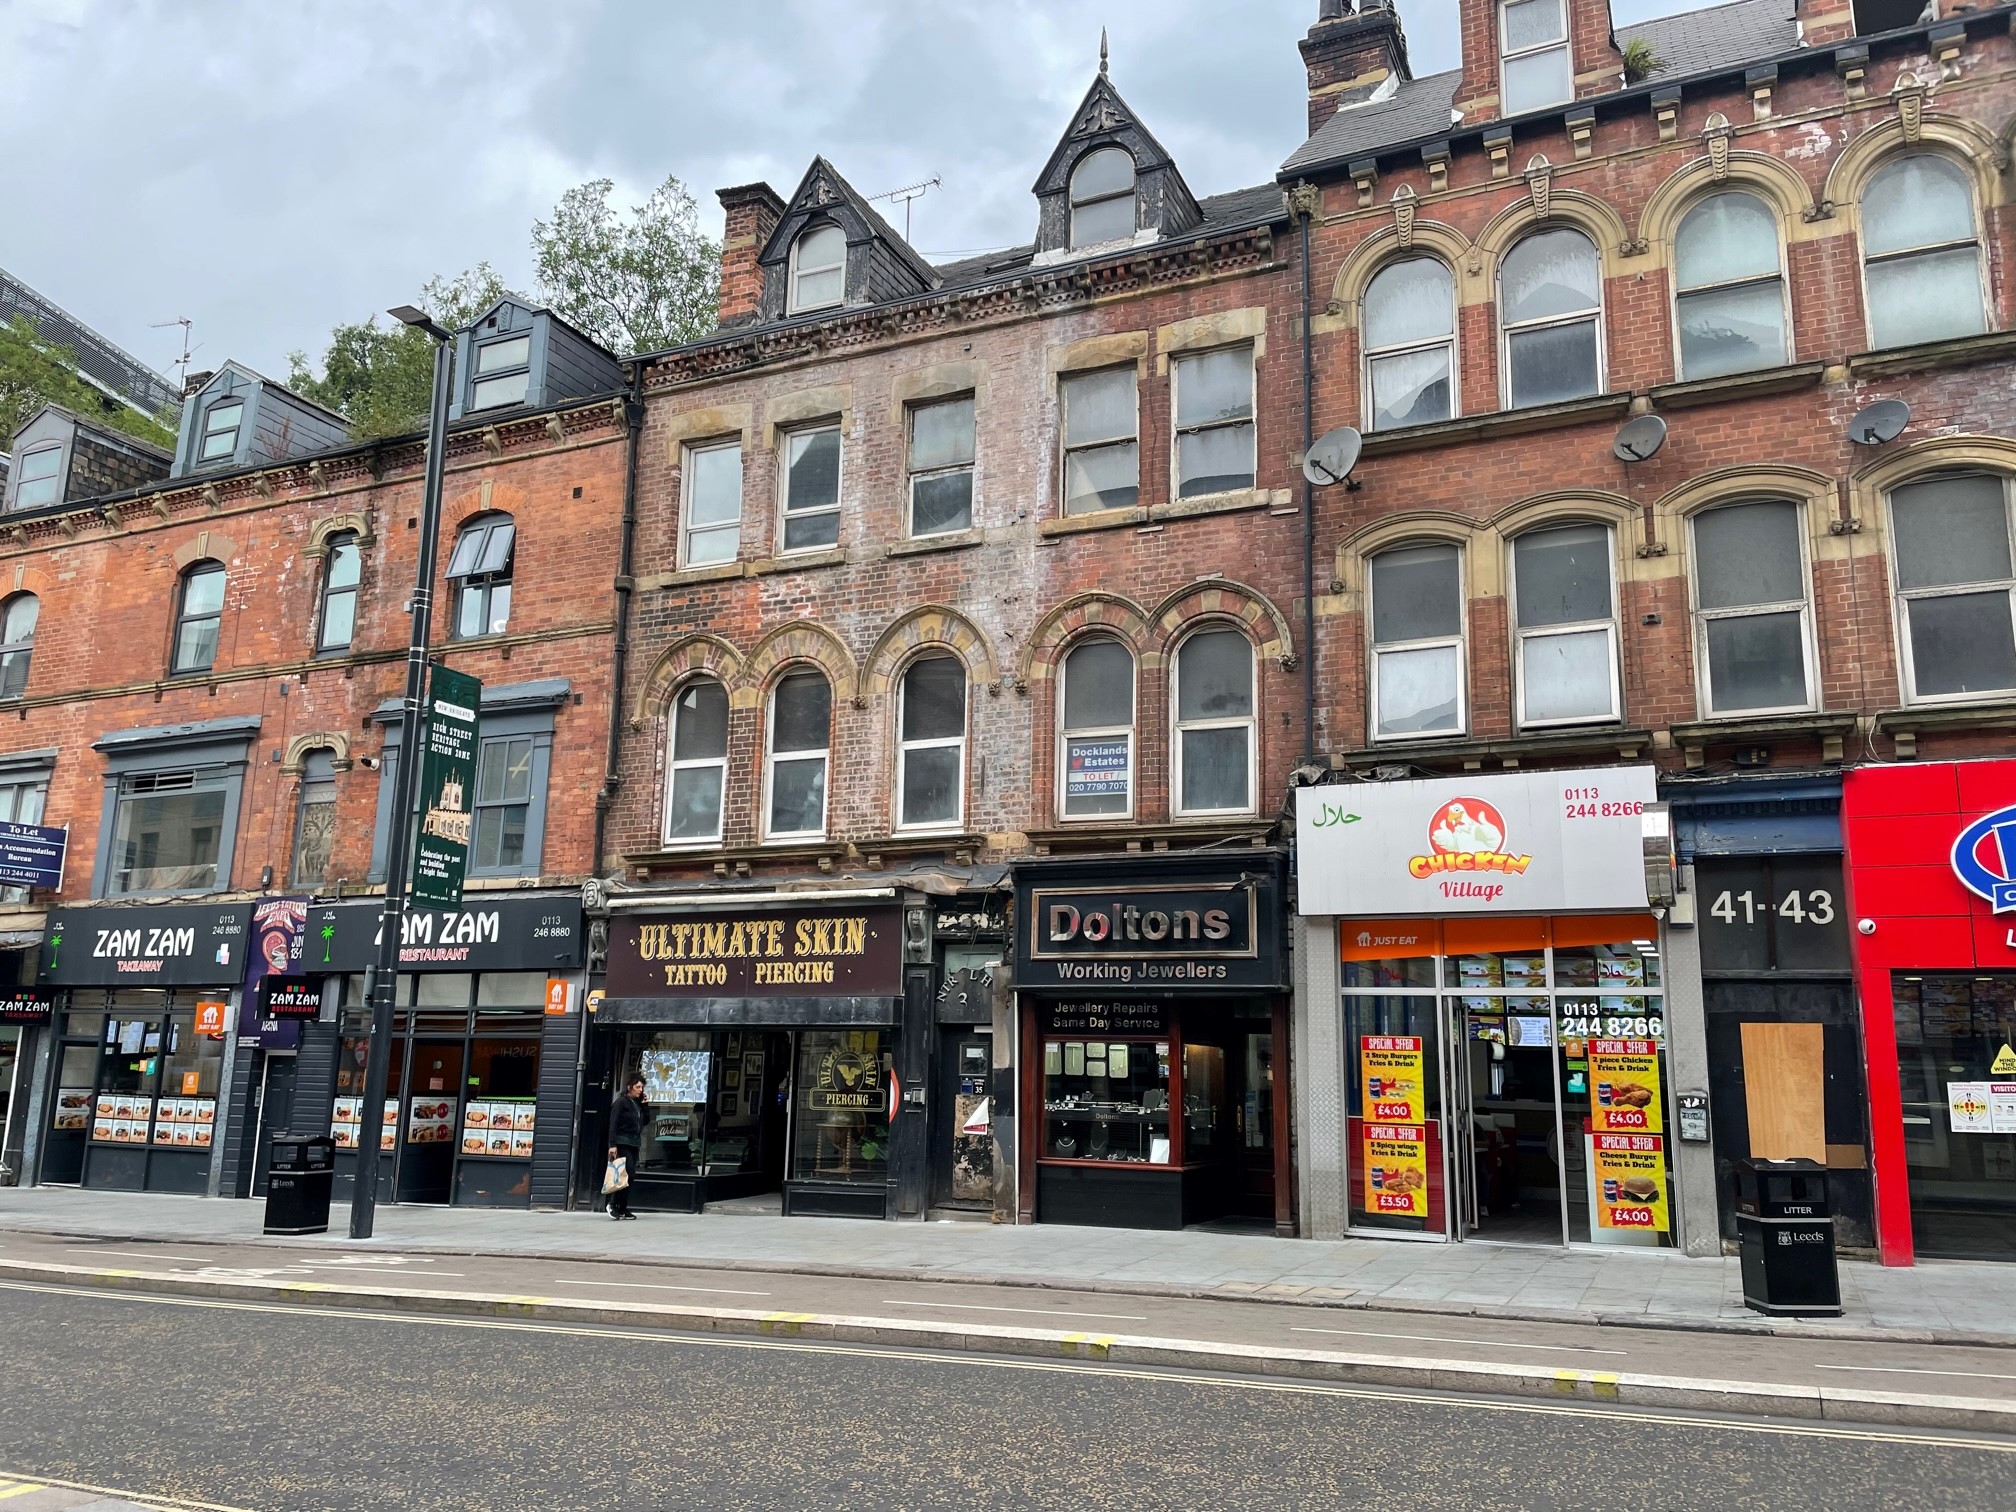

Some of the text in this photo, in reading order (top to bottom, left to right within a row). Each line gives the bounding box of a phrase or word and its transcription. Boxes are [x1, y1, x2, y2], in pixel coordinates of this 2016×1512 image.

[432, 732, 460, 748] HERITAGE
[449, 727, 472, 741] STREET
[431, 742, 471, 760] ACTION ZONE
[1072, 746, 1128, 757] Docklands
[1084, 757, 1125, 767] Estates
[1083, 772, 1115, 781] TO LET
[1565, 787, 1599, 800] 0113
[1312, 803, 1361, 827] حلال
[1566, 801, 1643, 818] 244 8266
[9, 825, 39, 836] To Let
[4, 844, 56, 857] Accommodation
[8, 853, 32, 863] Bureau
[1408, 851, 1533, 880] CHICKEN
[1439, 881, 1503, 901] Village
[219, 915, 235, 924] 0113
[541, 915, 561, 925] 0113
[1050, 903, 1231, 942] Doltons
[439, 911, 499, 944] ZAM
[533, 927, 570, 938] 246 8880
[93, 927, 195, 958] ZAM ZAM
[639, 917, 868, 960] ULTIMATE SKIN
[1373, 936, 1418, 946] JUST EAT
[399, 947, 469, 961] RESTAURANT
[117, 960, 164, 972] TAKEAWAY
[1057, 962, 1227, 982] Working Jewellers
[665, 961, 834, 986] TATTOO PIERCING
[270, 993, 319, 1006] ZAM ZAM
[0, 1001, 50, 1012] ZAM ZAM
[1055, 1003, 1158, 1015] Jewellery Repairs
[1564, 1003, 1598, 1016] 0113
[1053, 1017, 1160, 1030] Same Day Service
[1563, 1017, 1662, 1036] 244 8266
[1368, 1038, 1394, 1050] SPECIAL
[1597, 1041, 1626, 1053] SPECIAL
[1372, 1052, 1389, 1060] Strip
[1600, 1056, 1619, 1064] piece
[826, 1093, 869, 1106] PIERCING
[1378, 1105, 1408, 1116] £4.00
[1610, 1113, 1643, 1124] £4.00
[1371, 1127, 1396, 1139] SPECIAL
[1602, 1136, 1630, 1149] SPECIAL
[1380, 1196, 1409, 1207] £3.50
[1615, 1210, 1648, 1222] £4.00
[1783, 1206, 1812, 1214] LITTER
[1793, 1231, 1824, 1241] Leeds
